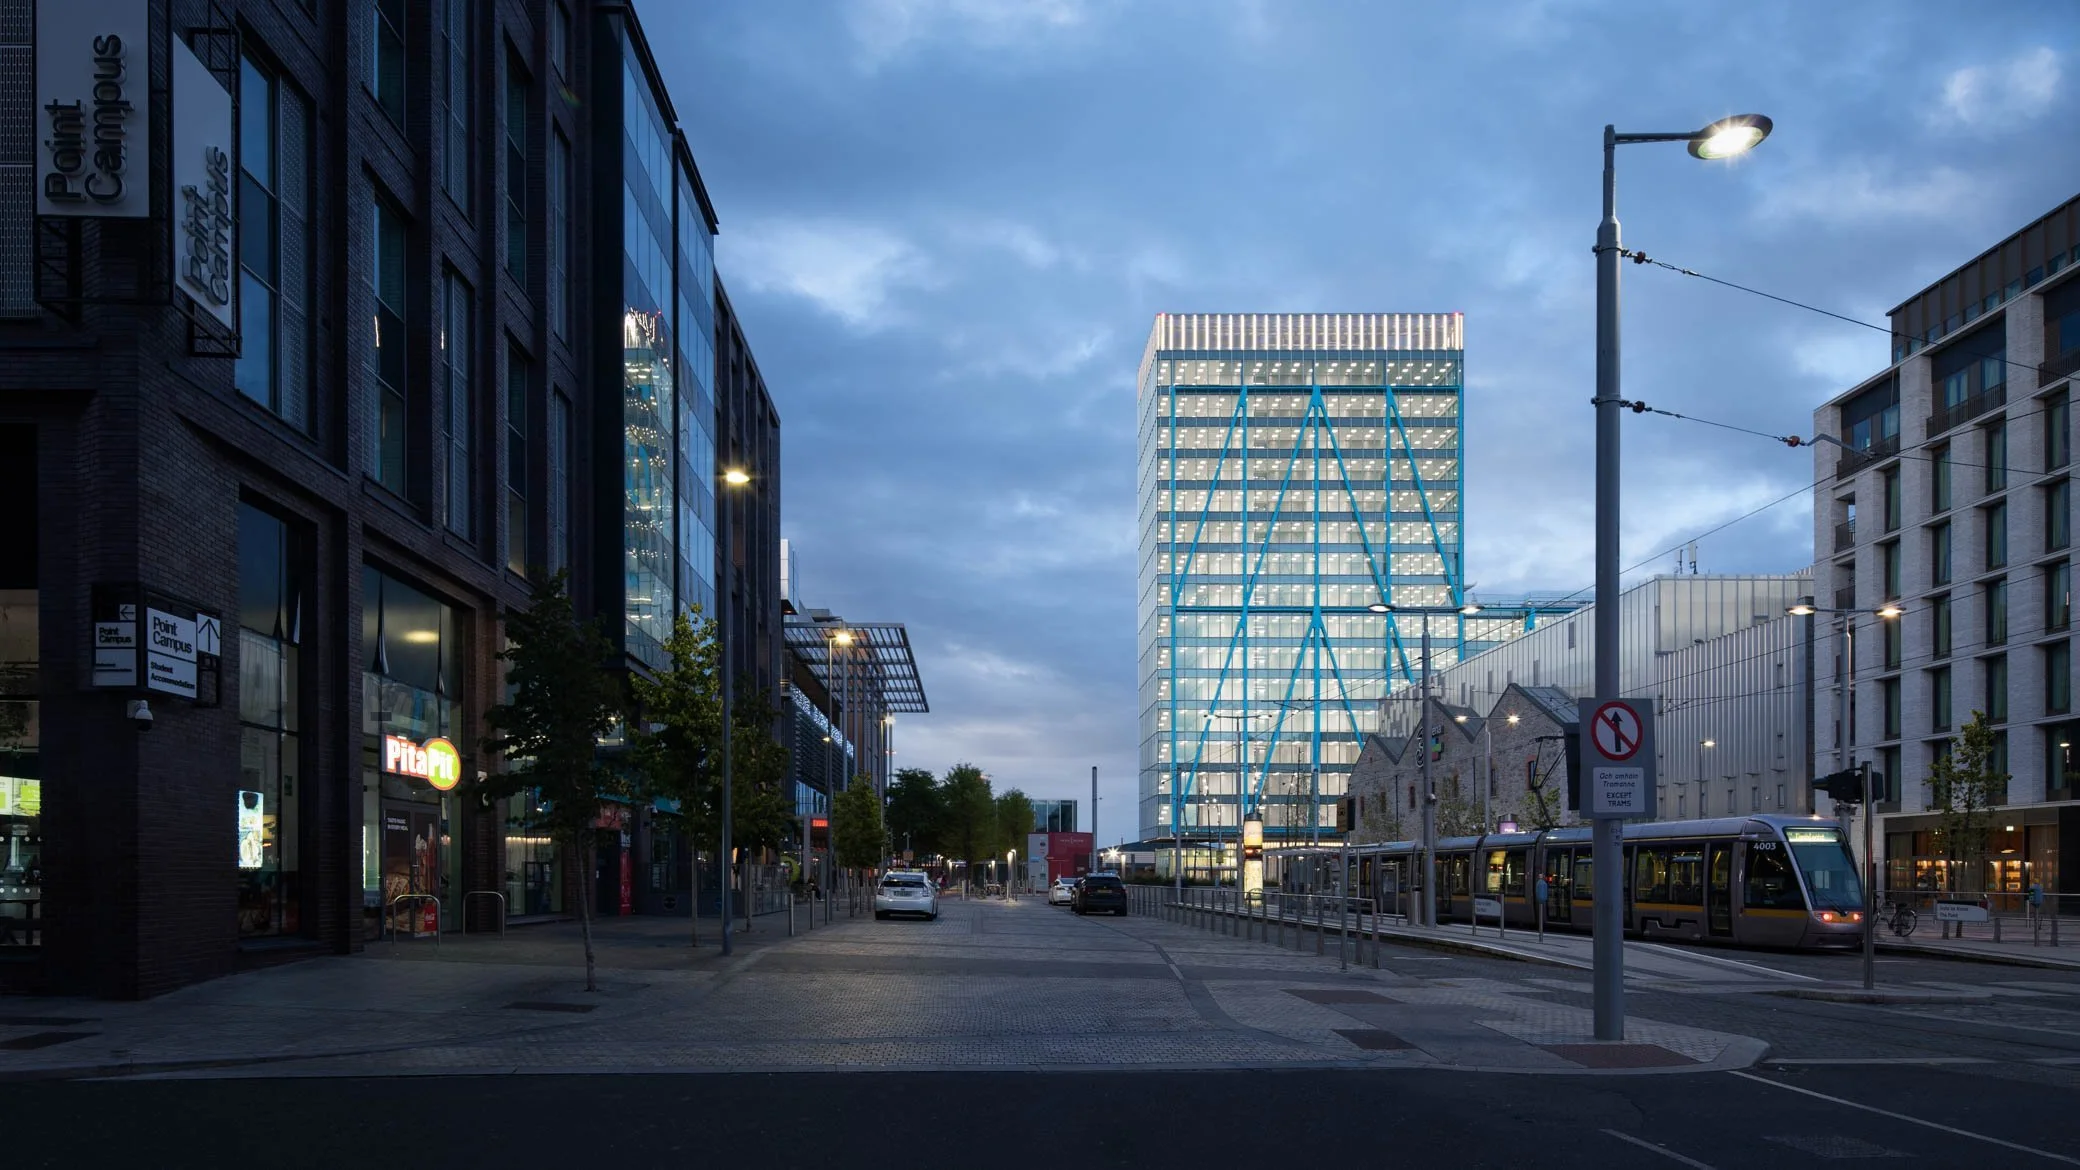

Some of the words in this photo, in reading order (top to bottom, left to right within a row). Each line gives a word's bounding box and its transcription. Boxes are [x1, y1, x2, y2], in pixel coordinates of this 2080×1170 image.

[85, 34, 134, 205] Campus
[44, 98, 85, 203] Point
[206, 145, 232, 306] Campus
[181, 184, 208, 293] Point
[99, 627, 118, 635] Point
[153, 616, 178, 636] Point
[99, 635, 131, 644] Campus
[153, 630, 193, 654] Campus
[150, 661, 174, 674] Student
[1606, 791, 1632, 799] EXCEPT
[1753, 842, 1777, 851] 4003
